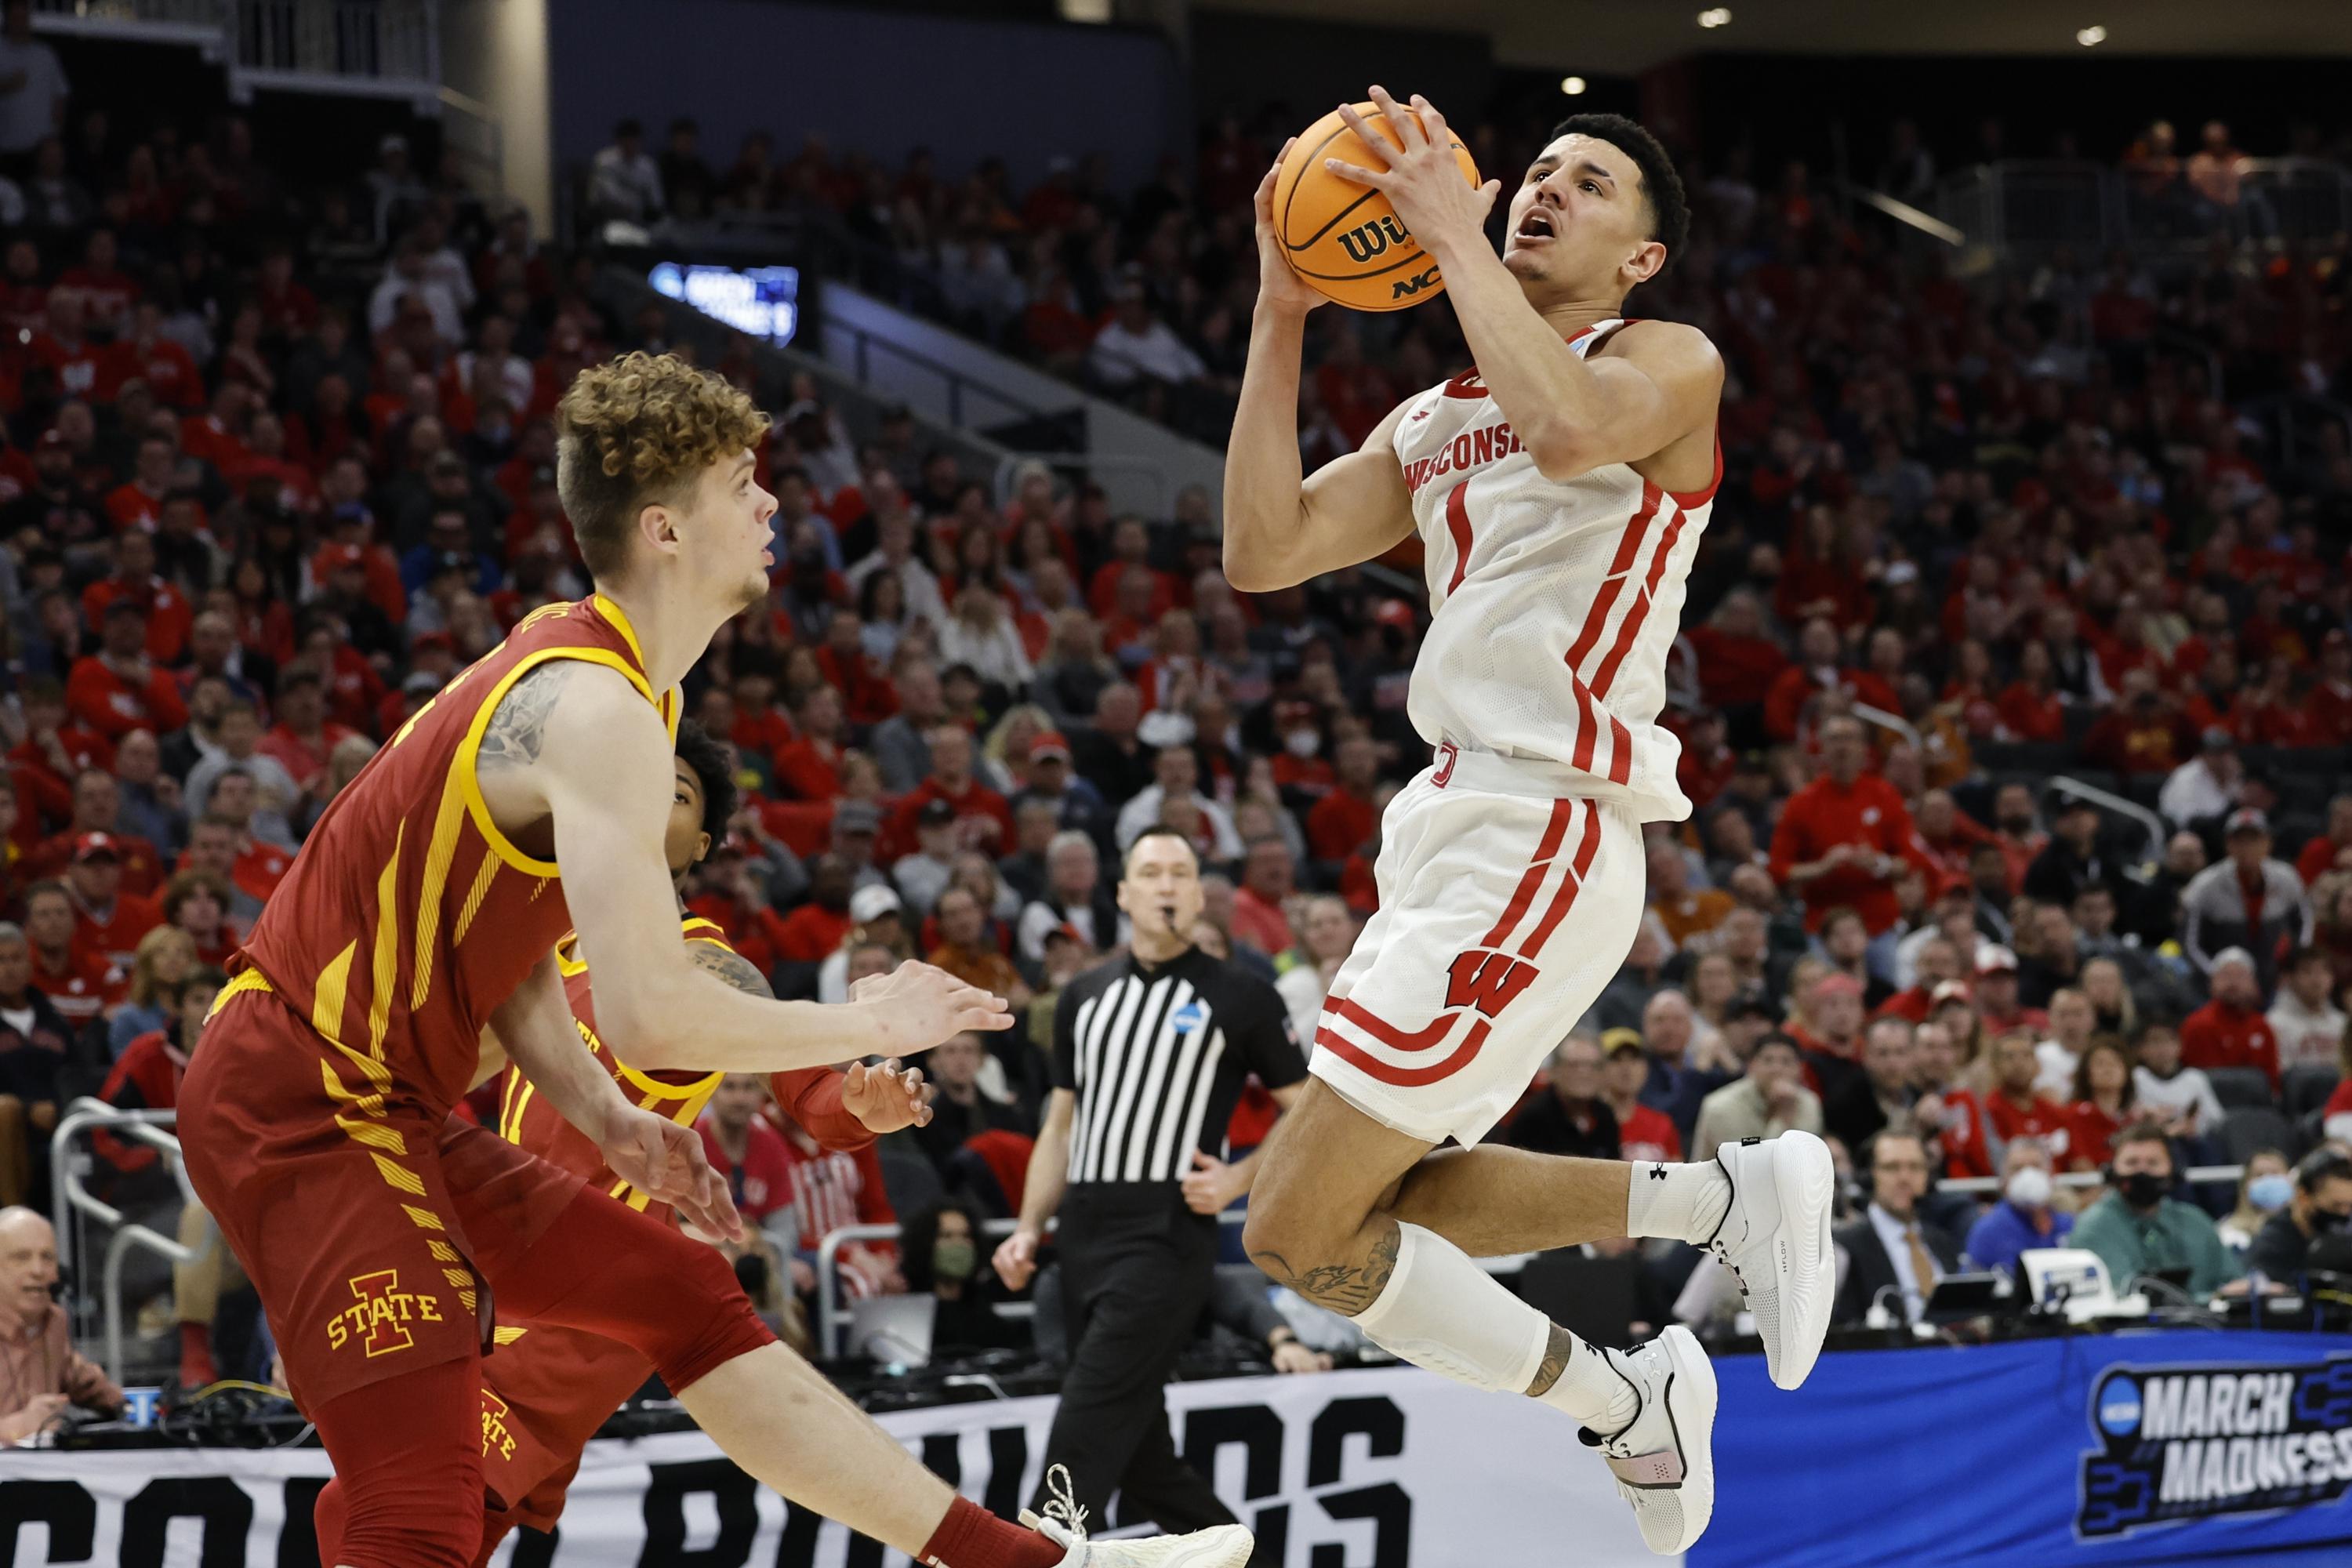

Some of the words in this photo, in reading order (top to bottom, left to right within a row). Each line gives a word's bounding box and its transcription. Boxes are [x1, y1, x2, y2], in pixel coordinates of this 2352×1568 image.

[1403, 422, 1529, 498] WISCONSI
[1443, 949, 1541, 1020] W
[327, 1294, 443, 1350] STATE
[2141, 1373, 2295, 1440] MARCH
[2159, 1427, 2352, 1502] MADNESS
